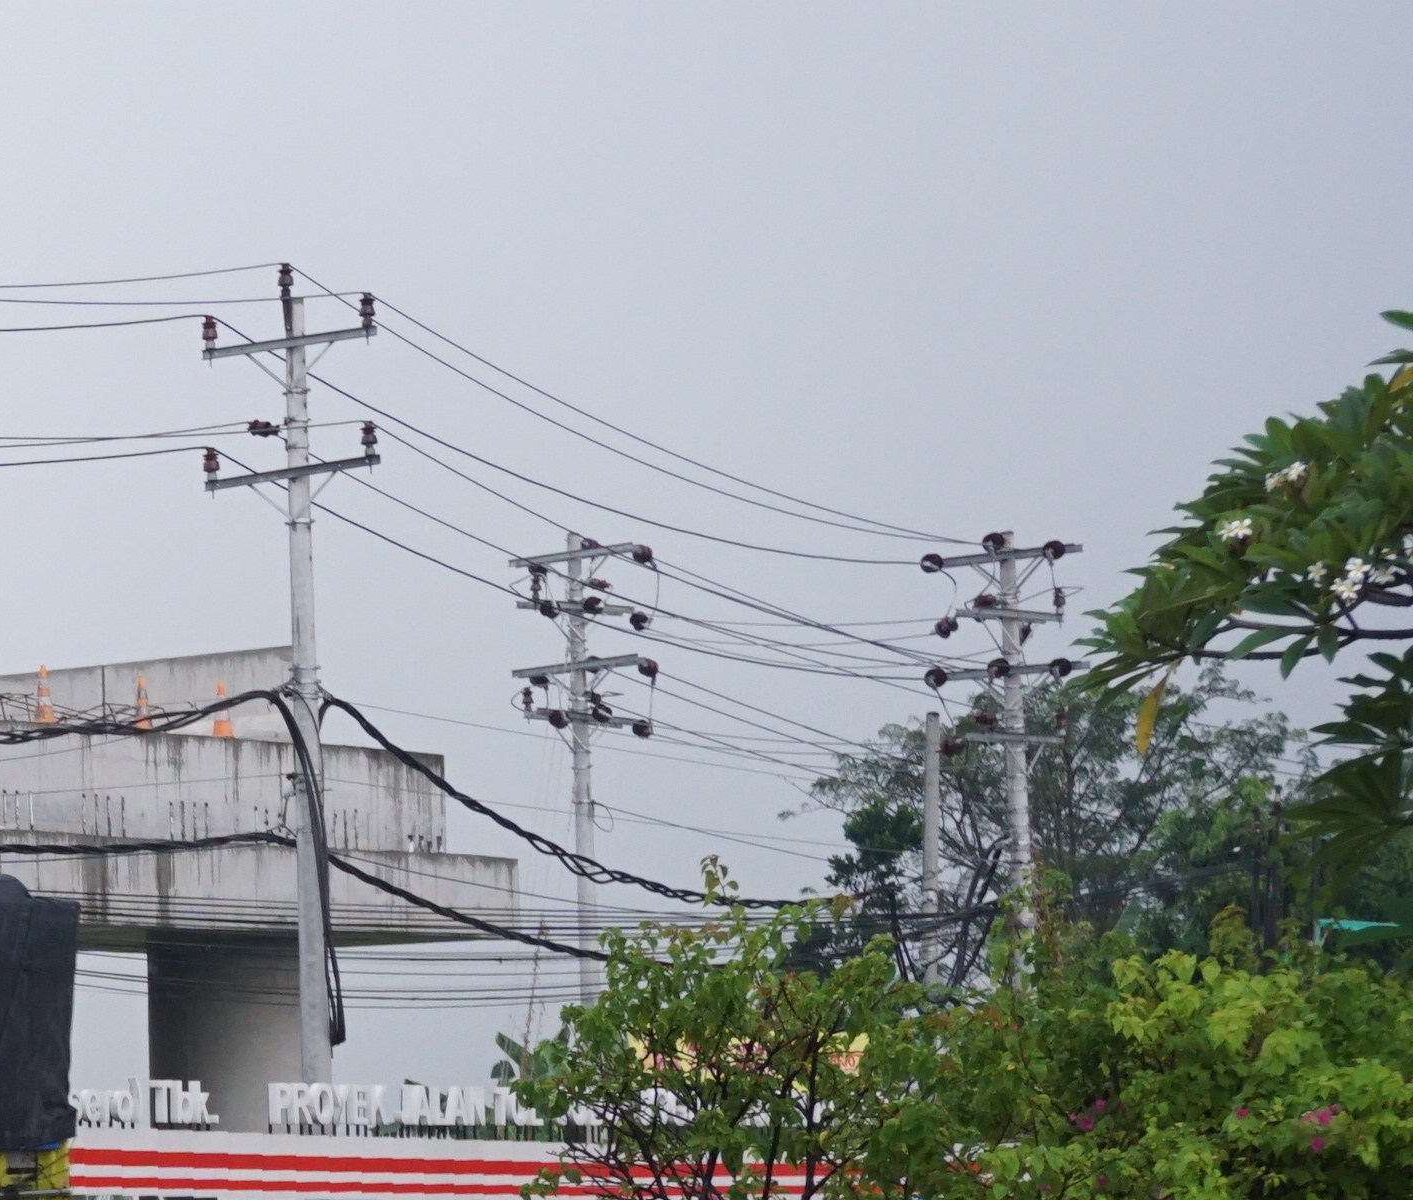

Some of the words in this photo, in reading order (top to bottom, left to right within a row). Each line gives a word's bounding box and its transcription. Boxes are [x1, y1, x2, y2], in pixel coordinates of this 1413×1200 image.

[149, 1079, 220, 1125] Tbk.
[267, 1082, 386, 1127] PROYEK
[394, 1084, 486, 1127] JALAN
